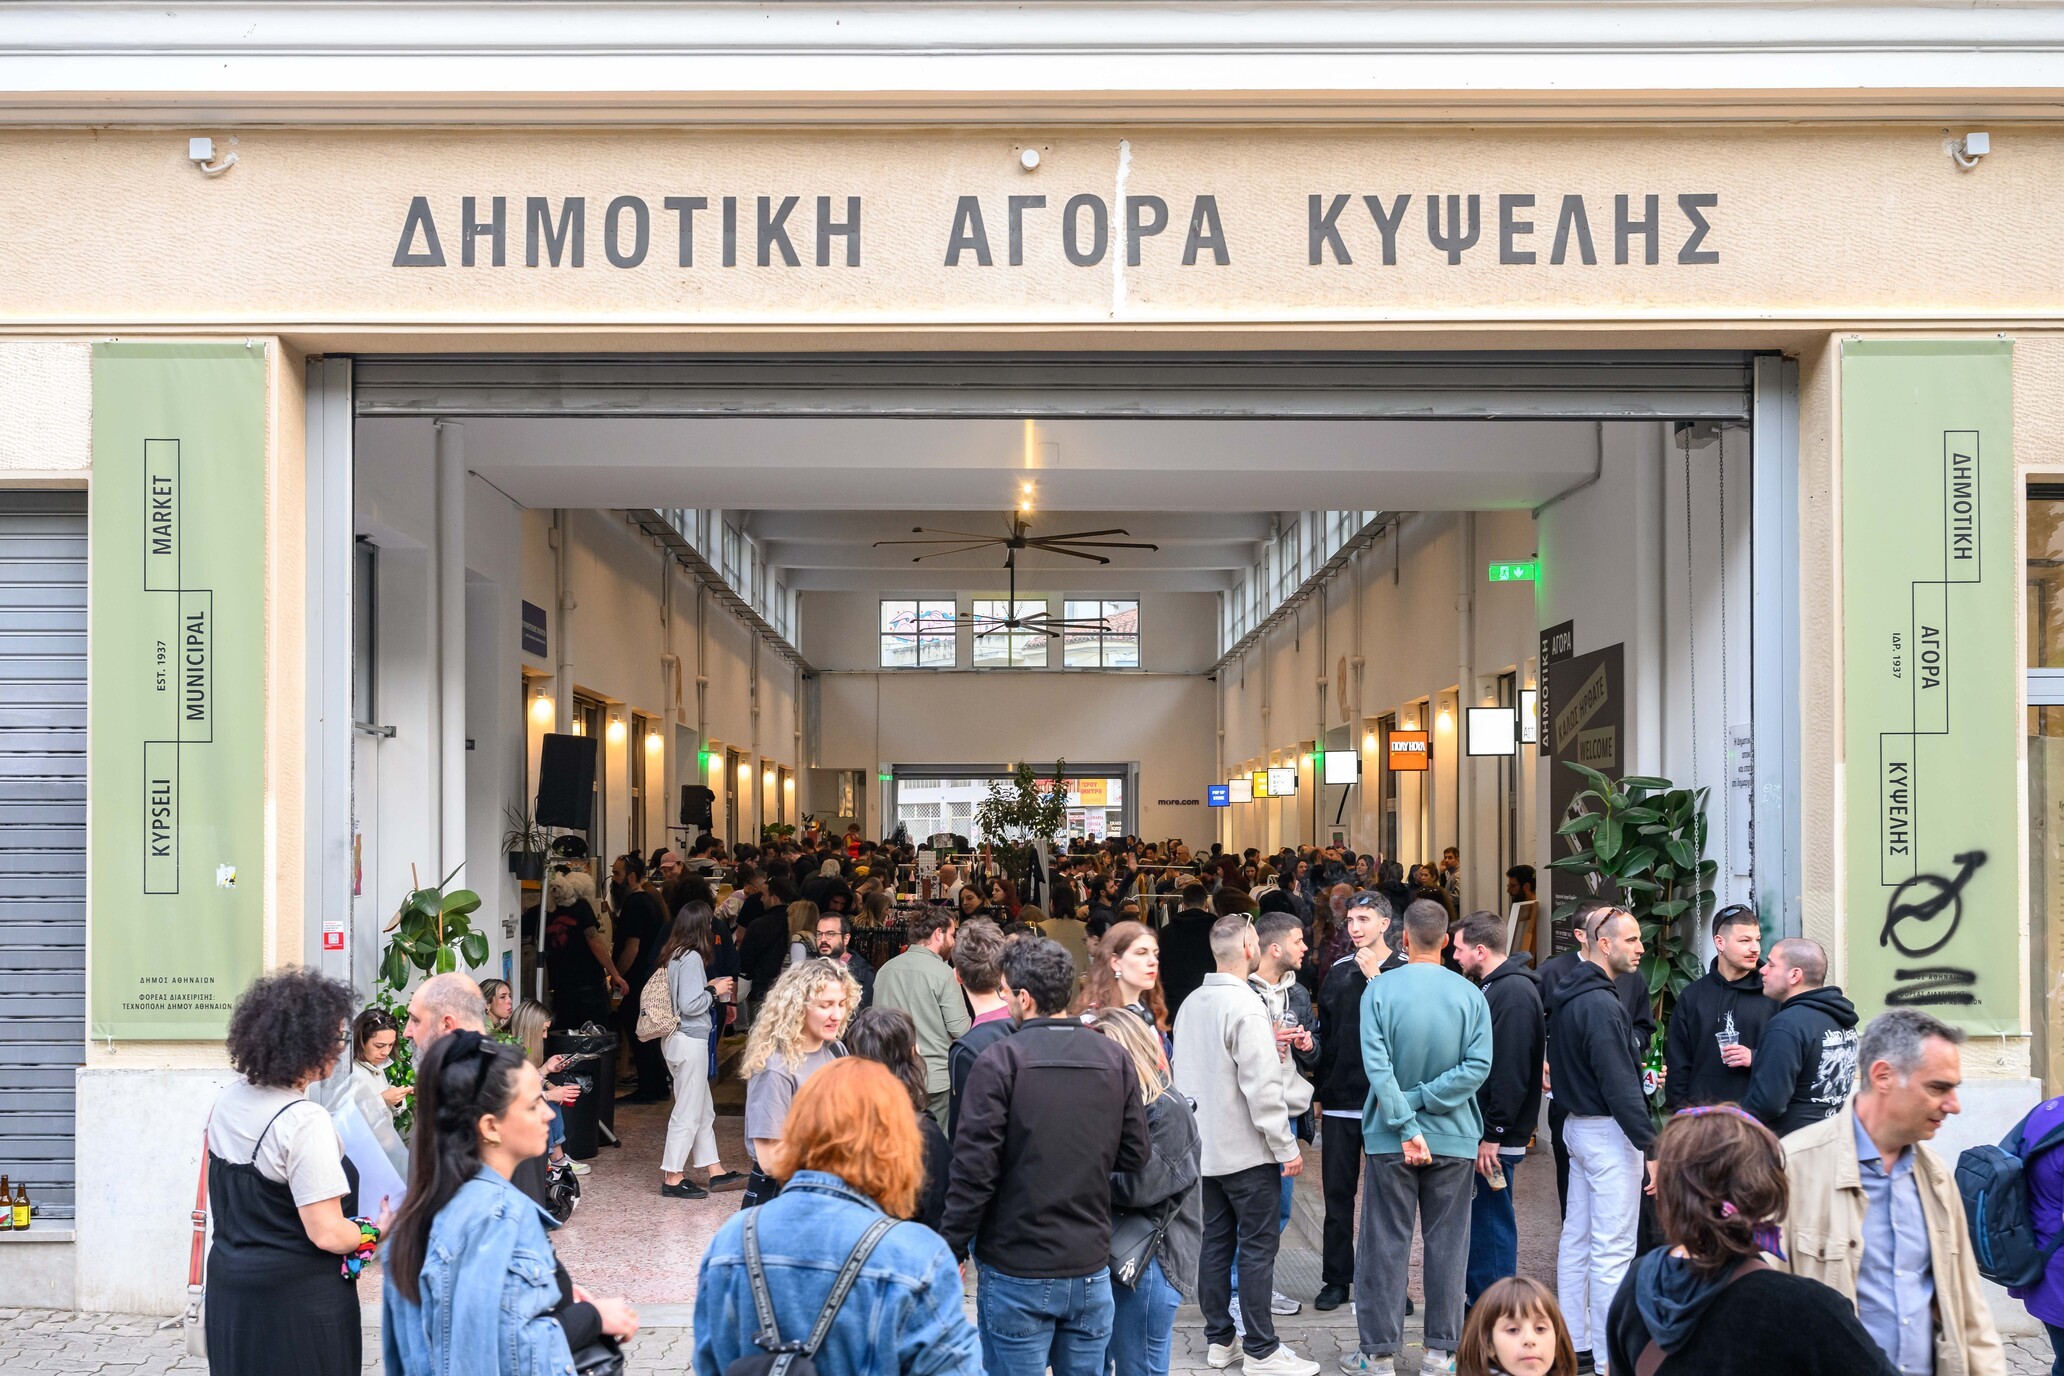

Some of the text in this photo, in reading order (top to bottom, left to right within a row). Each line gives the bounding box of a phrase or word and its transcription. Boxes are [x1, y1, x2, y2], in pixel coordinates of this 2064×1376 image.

[391, 193, 1720, 268] ΔΗΜΟΤΙΚΗ ΑΓΟΡΑ ΚΥΨΕΛΗΣ
[151, 474, 172, 556] MARKET
[1952, 452, 1973, 560] ΔΗΜΟΤΙΚΗ
[156, 639, 167, 692] EST. 1937
[185, 610, 206, 721] MUNICIPAL
[1551, 630, 1572, 656] ΑΓΟΡΑ
[1892, 632, 1902, 680] ΙΔΡ. 1937
[1920, 625, 1941, 690] ΑΓΟΡΑ
[1541, 638, 1550, 748] ΔΗΜΟΤΙΚΗ
[1557, 675, 1605, 745] ΚΑΛΩΣ ΗΡΘΑΤΕ
[1579, 736, 1613, 762] WELCOME
[151, 779, 171, 857] KYPSELI
[1888, 762, 1909, 856] ΚΥΨΕΛΗΣ
[138, 993, 216, 1001] ΦΟΡΕΑΣ ΔΙΑΧΕΙΡΙΣΗΣ:
[139, 976, 216, 984] ΔΗΜΟΣ ΑΘΗΝΑΙΩΝ
